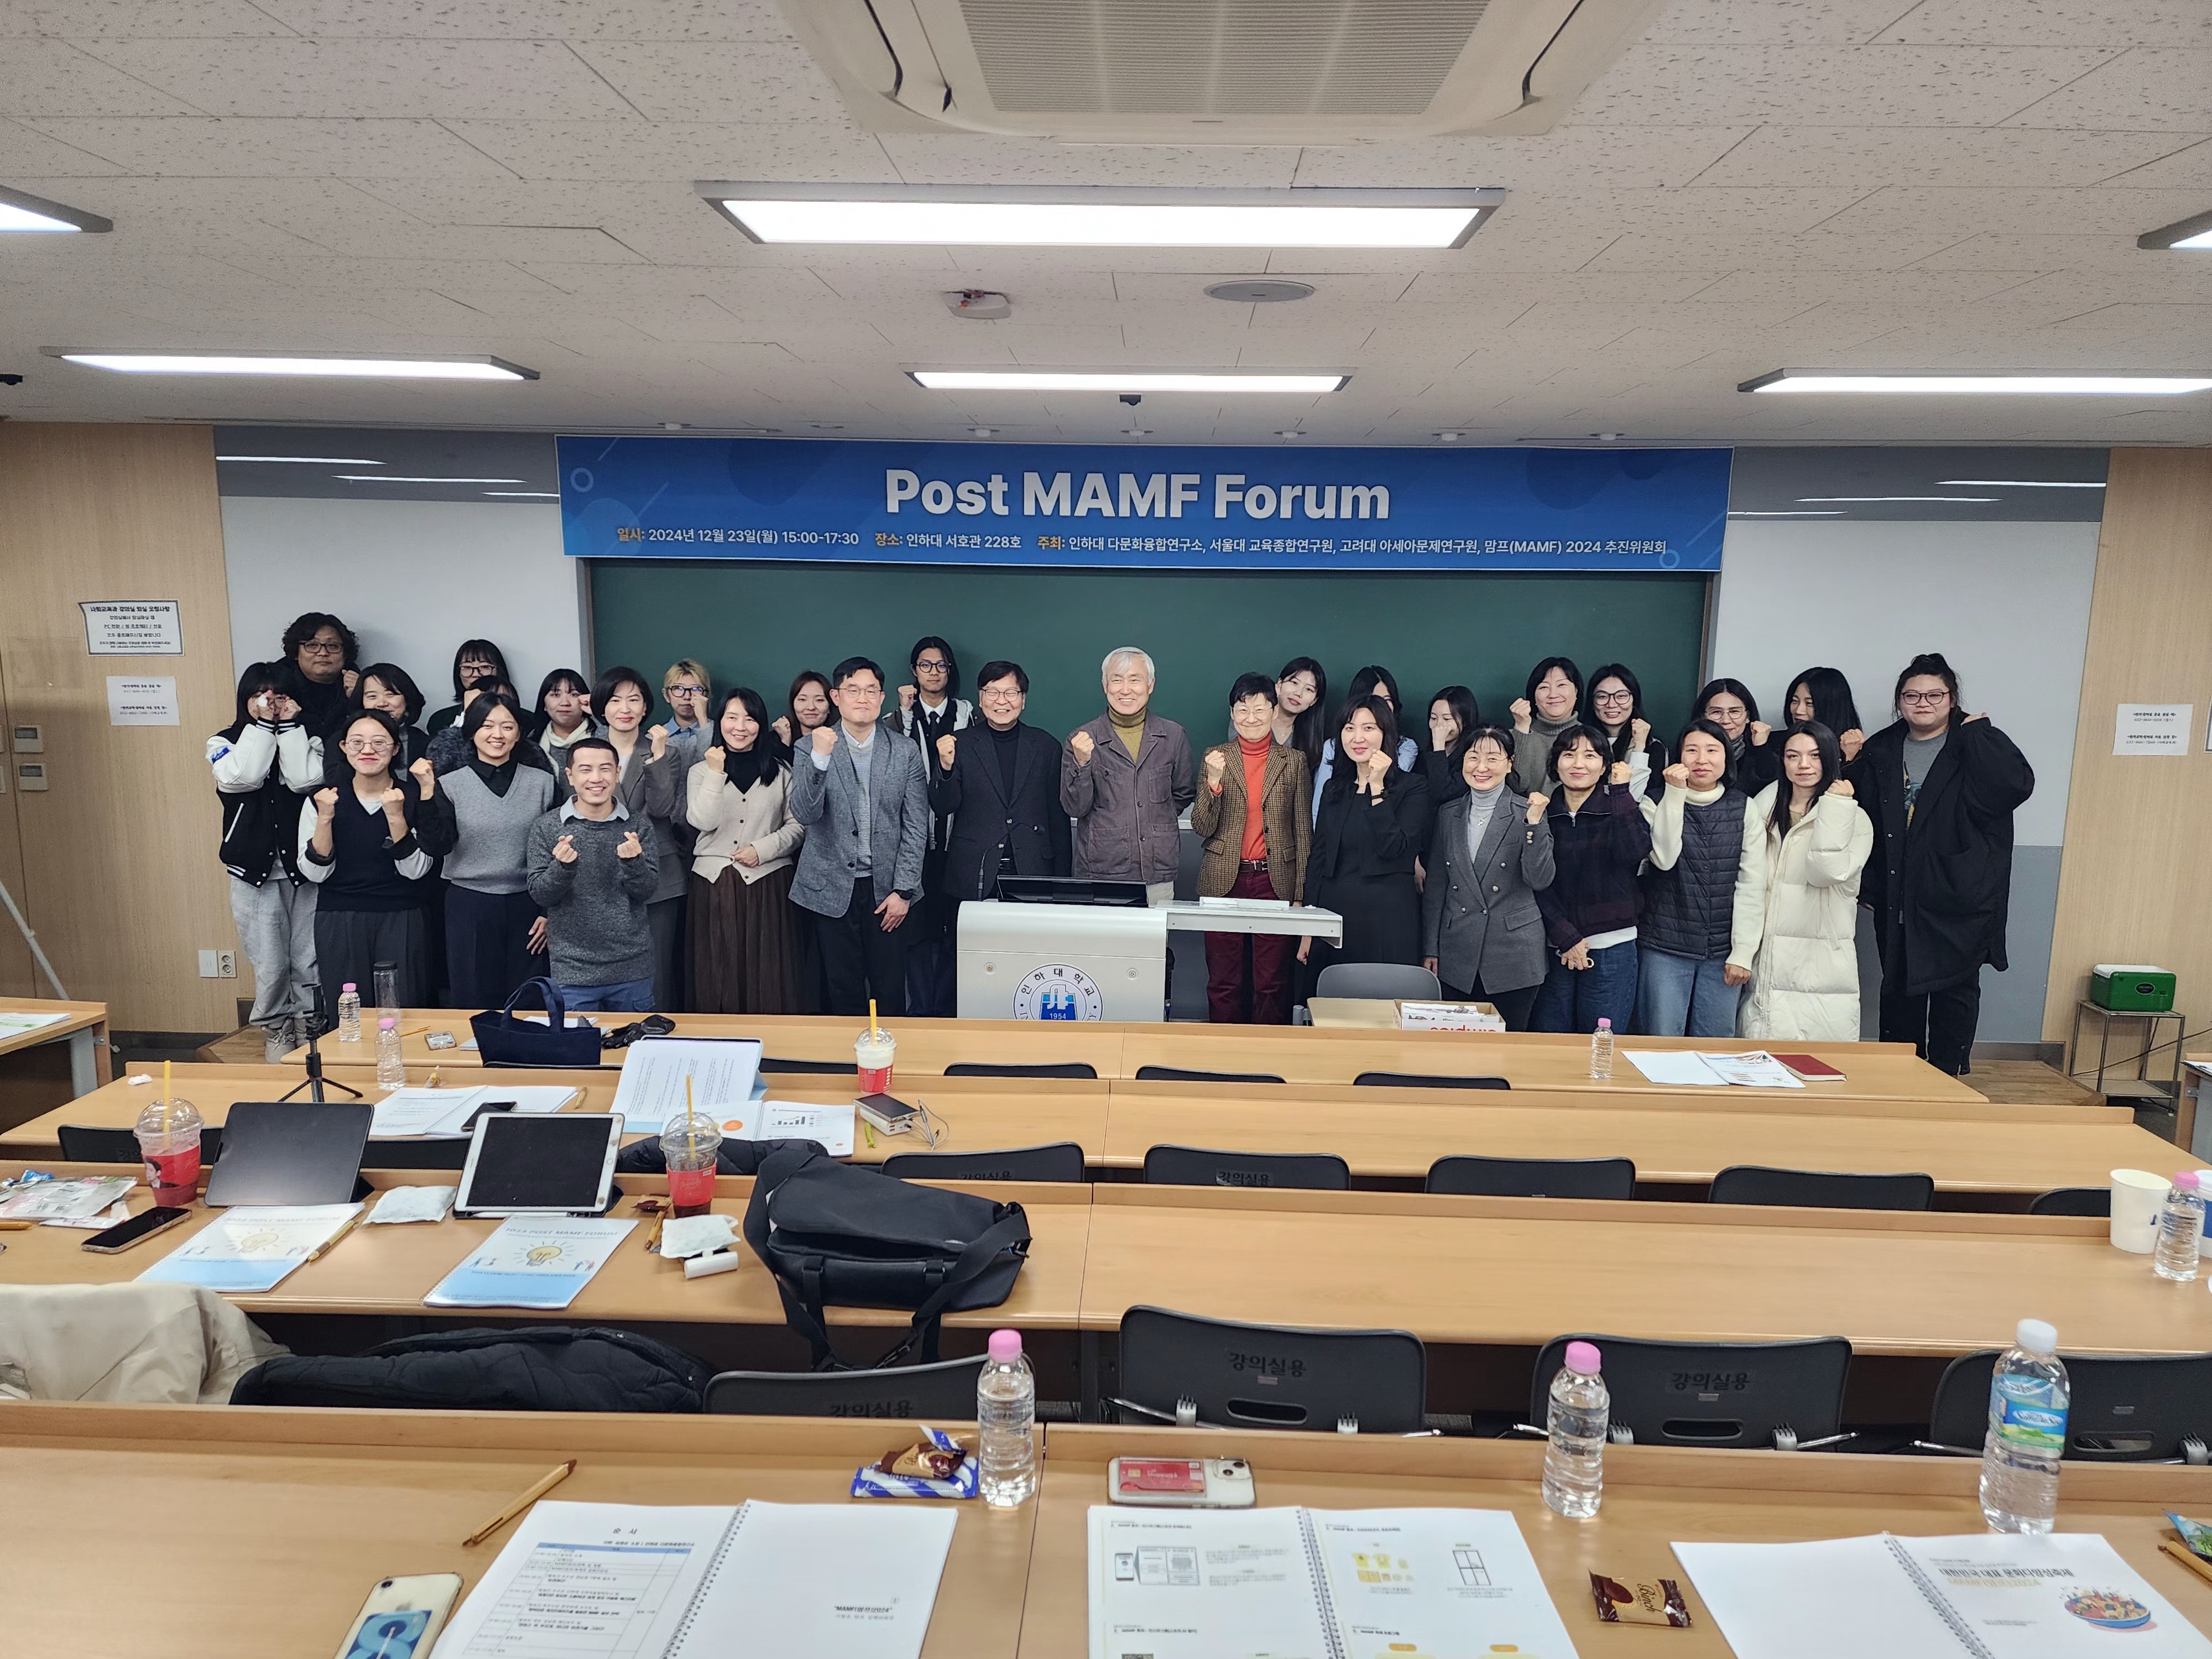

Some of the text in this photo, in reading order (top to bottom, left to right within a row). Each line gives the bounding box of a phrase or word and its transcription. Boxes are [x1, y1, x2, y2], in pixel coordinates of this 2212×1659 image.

[885, 469, 1390, 519] Post MAMF Forum
[617, 527, 1667, 555] 일시: 2024년 12월 23일(월) 15:00-17:30 장소: 인하대 서호관 228호 주최: 인하대 다문화융합연구소, 서울대 교육종합연구원, 고려대 아세아문제연구원, 맘프(MAMF) 2024 추진위원회
[1021, 968, 1095, 997] 인하대학교
[1229, 1353, 1307, 1378] 강의실용
[1671, 1372, 1751, 1391] 강의실용
[1637, 1583, 1662, 1614] Binch
